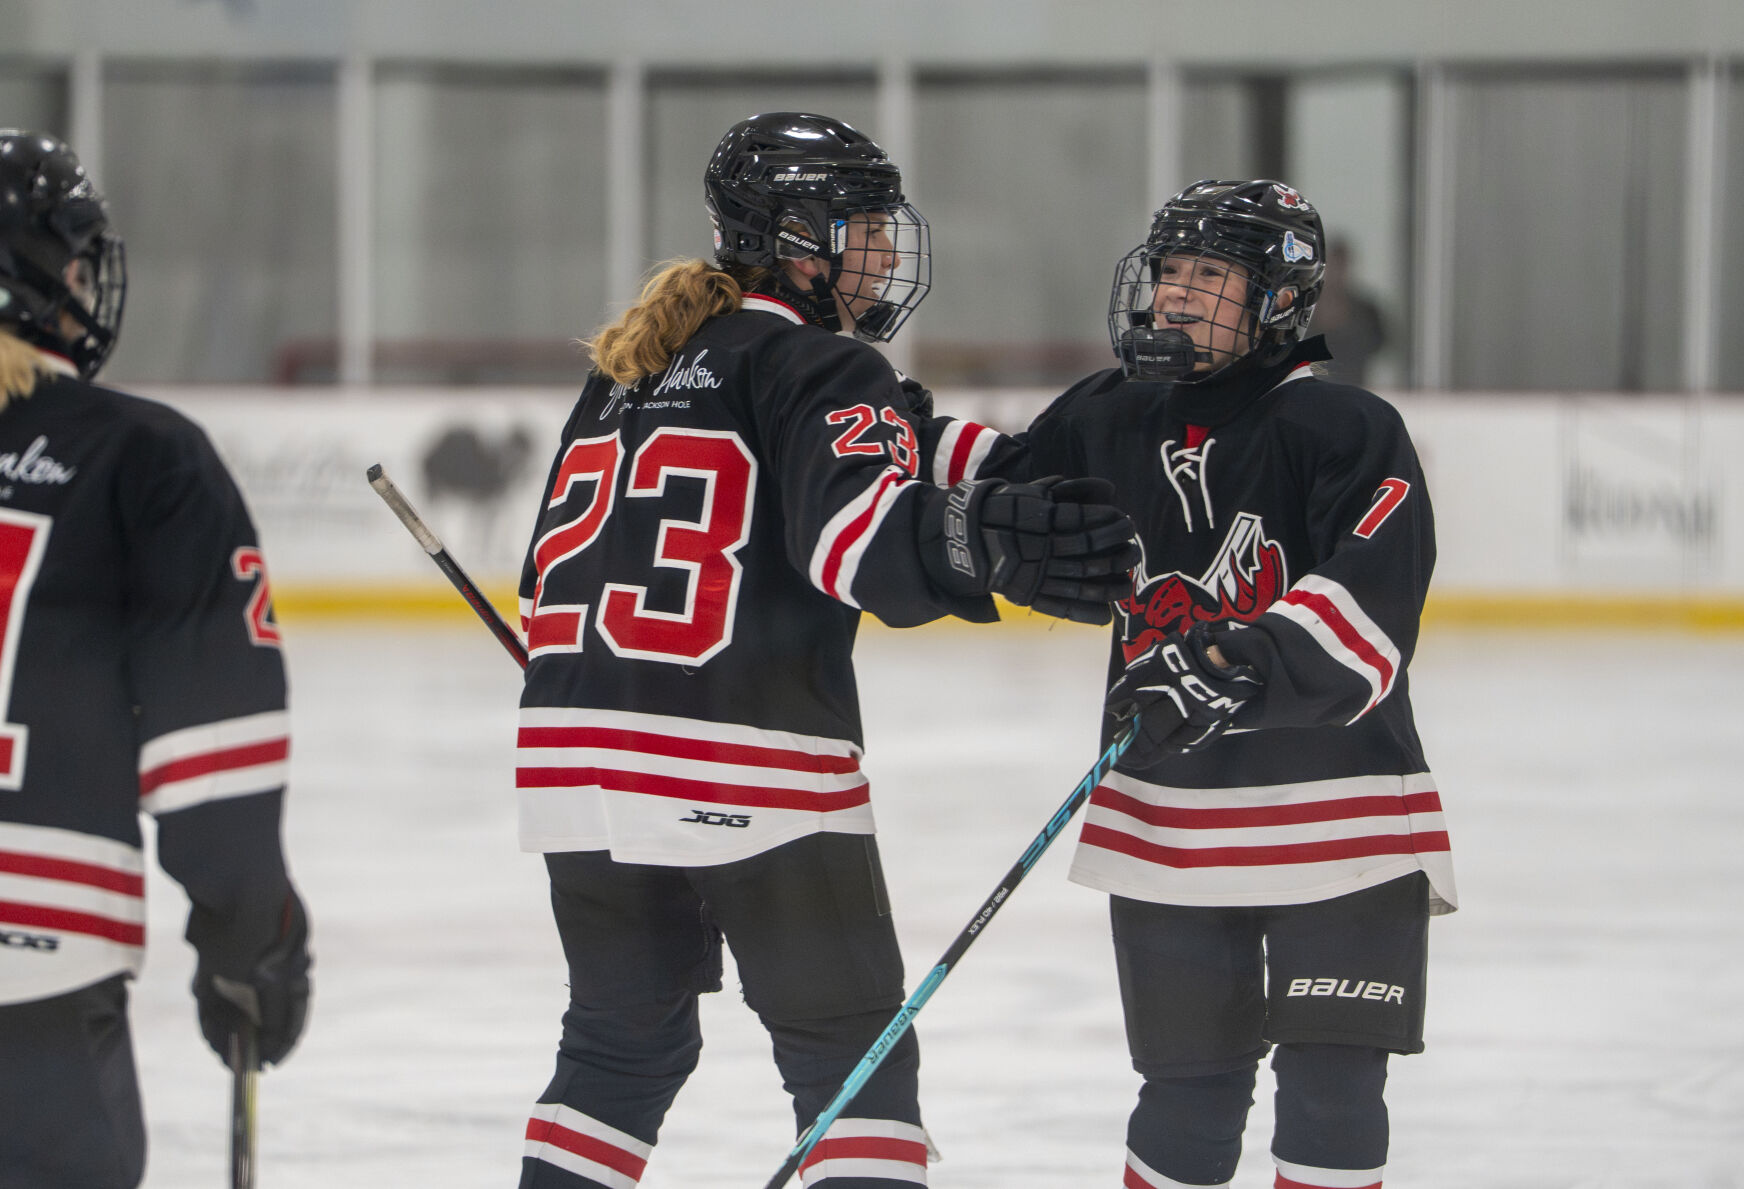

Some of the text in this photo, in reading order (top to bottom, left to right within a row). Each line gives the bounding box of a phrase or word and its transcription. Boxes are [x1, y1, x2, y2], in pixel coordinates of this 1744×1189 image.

[773, 173, 828, 182] BAUER
[778, 231, 820, 252] BAUER
[671, 400, 692, 409] HOLE
[824, 403, 920, 479] 23
[528, 426, 758, 667] 23
[943, 480, 977, 578] BAU
[231, 546, 284, 648] 2
[1161, 643, 1248, 714] CCM
[678, 809, 753, 829] JOG
[1287, 978, 1406, 1005] BAUER
[863, 1011, 908, 1065] BAUER
